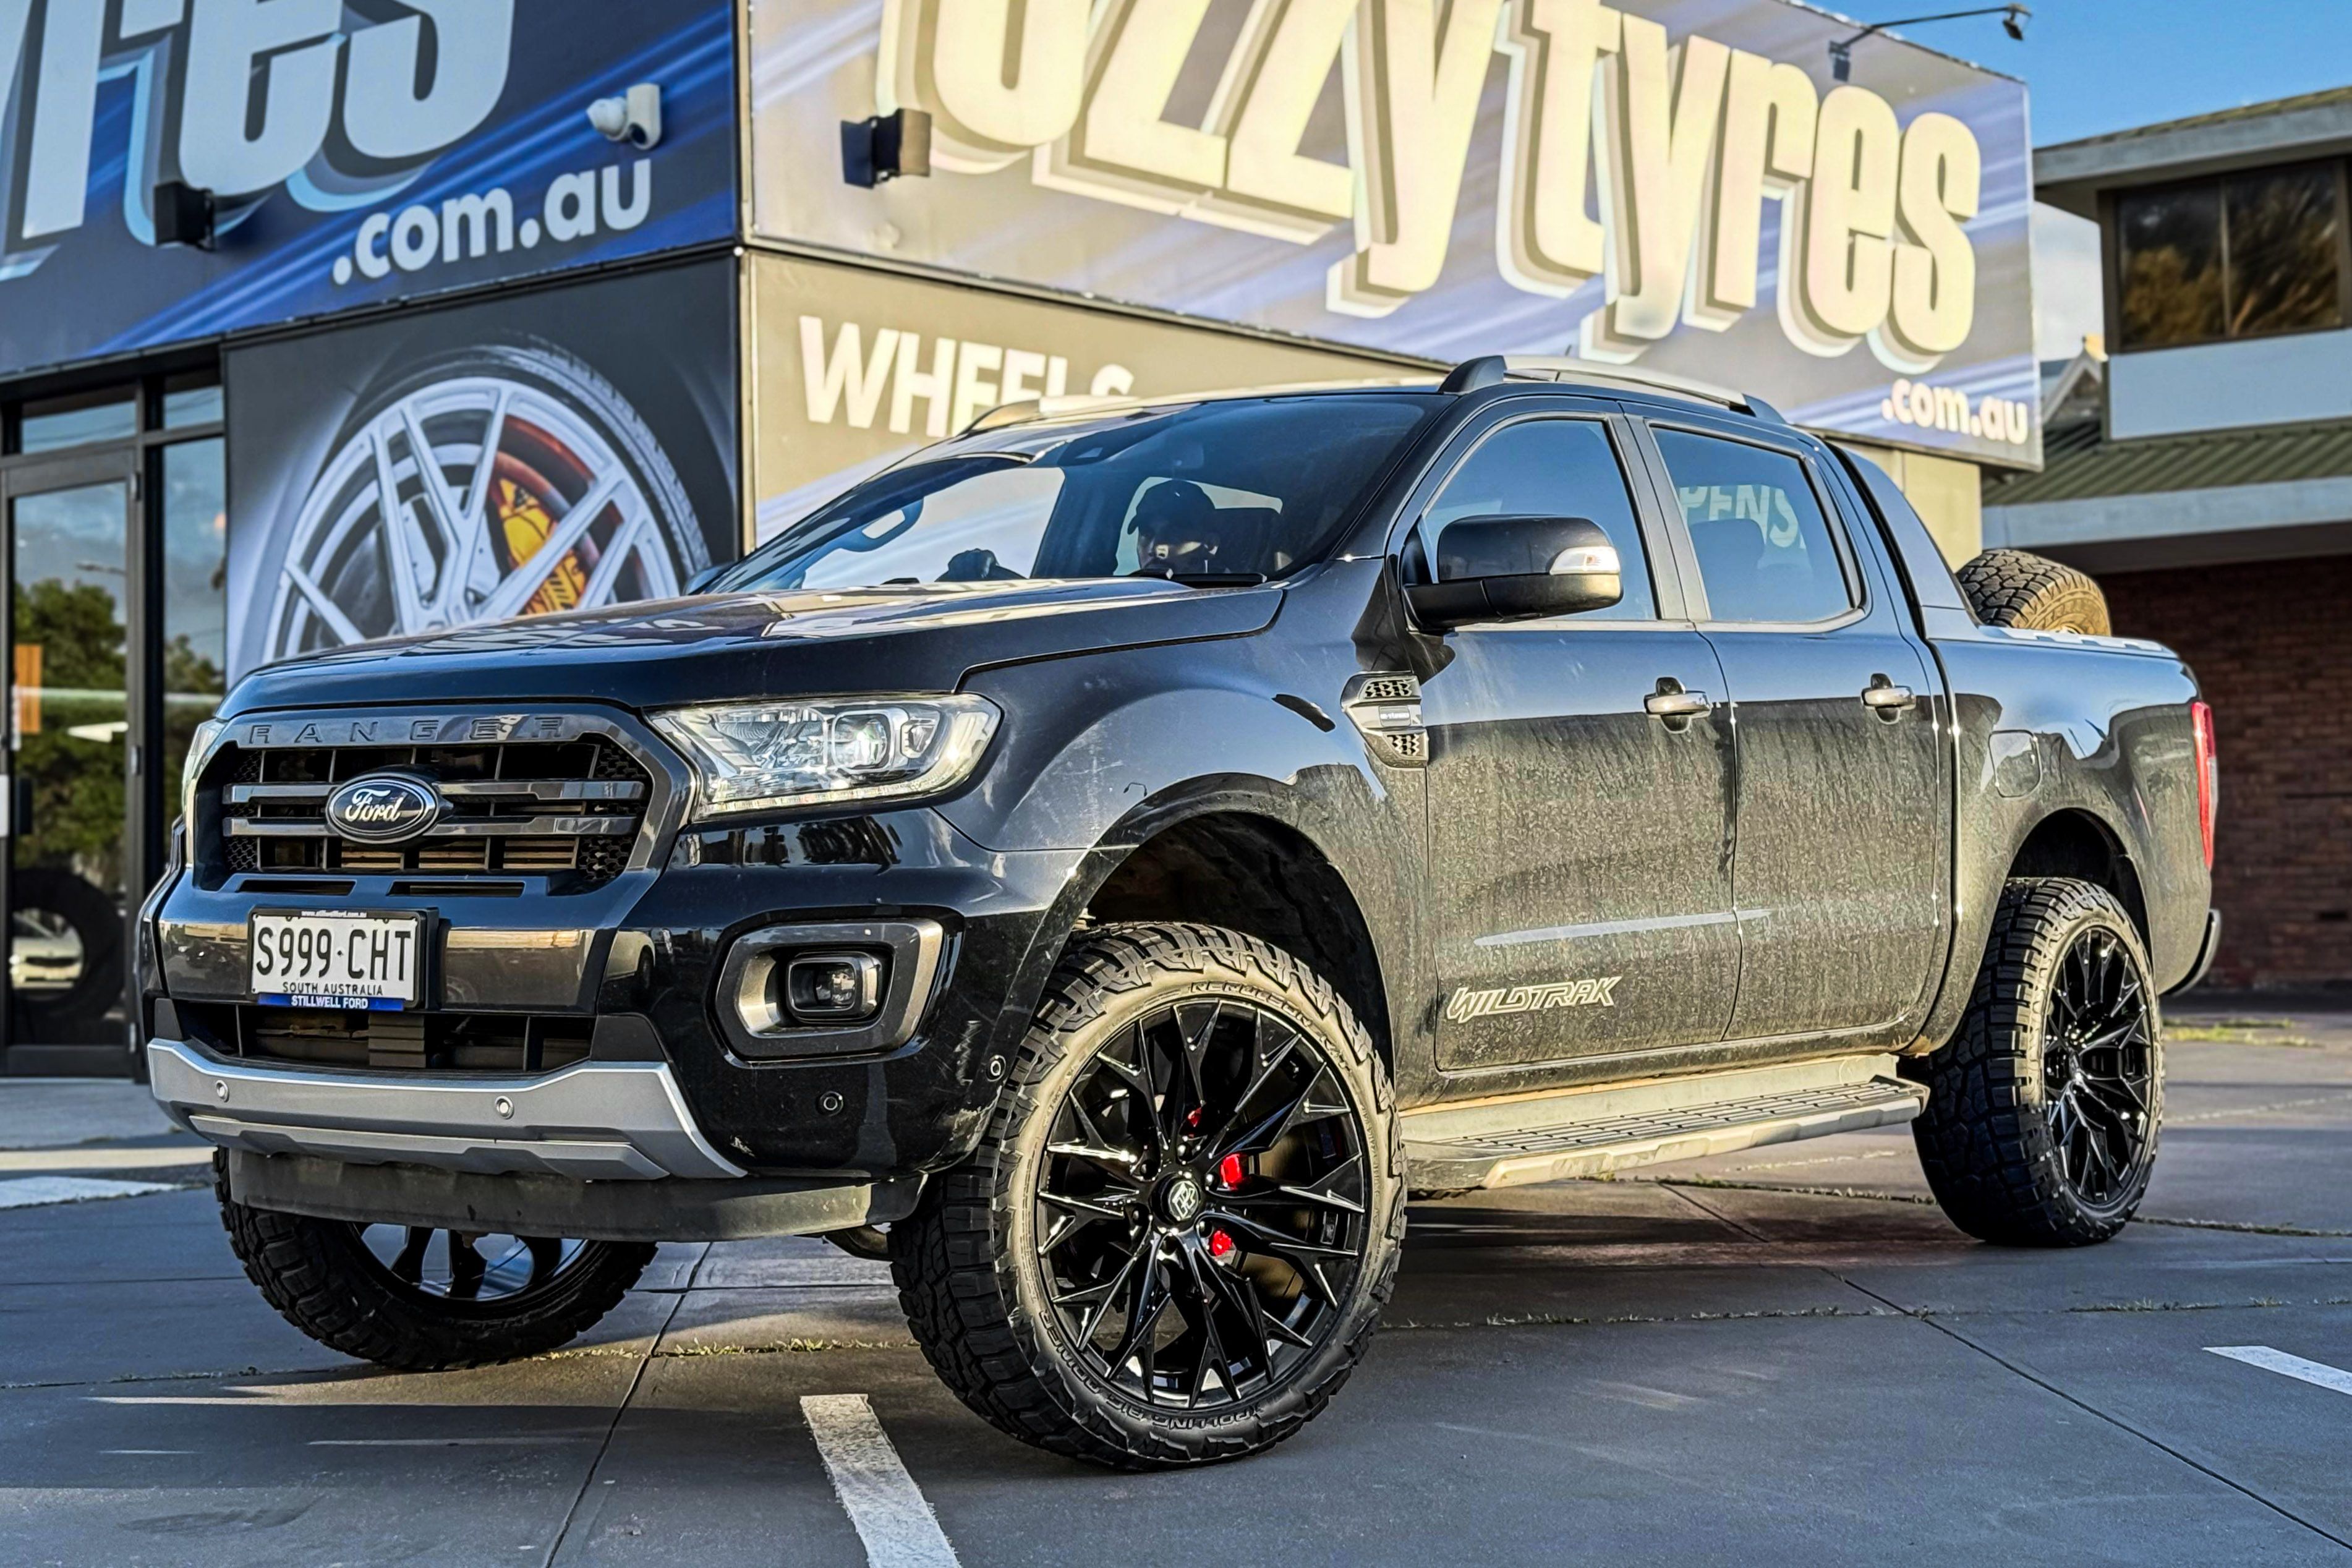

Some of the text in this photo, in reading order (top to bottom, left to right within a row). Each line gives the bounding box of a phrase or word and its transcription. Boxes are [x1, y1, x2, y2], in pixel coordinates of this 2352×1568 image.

[332, 158, 651, 285] .com.au
[1881, 378, 2029, 445] .com.au
[249, 717, 563, 744] RANGER
[345, 788, 406, 822] Ford
[283, 981, 383, 996] SOUTH AUSTRALIA
[291, 995, 369, 1010] STILLWELL FORD
[1446, 976, 1622, 1024] WILDTRAK
